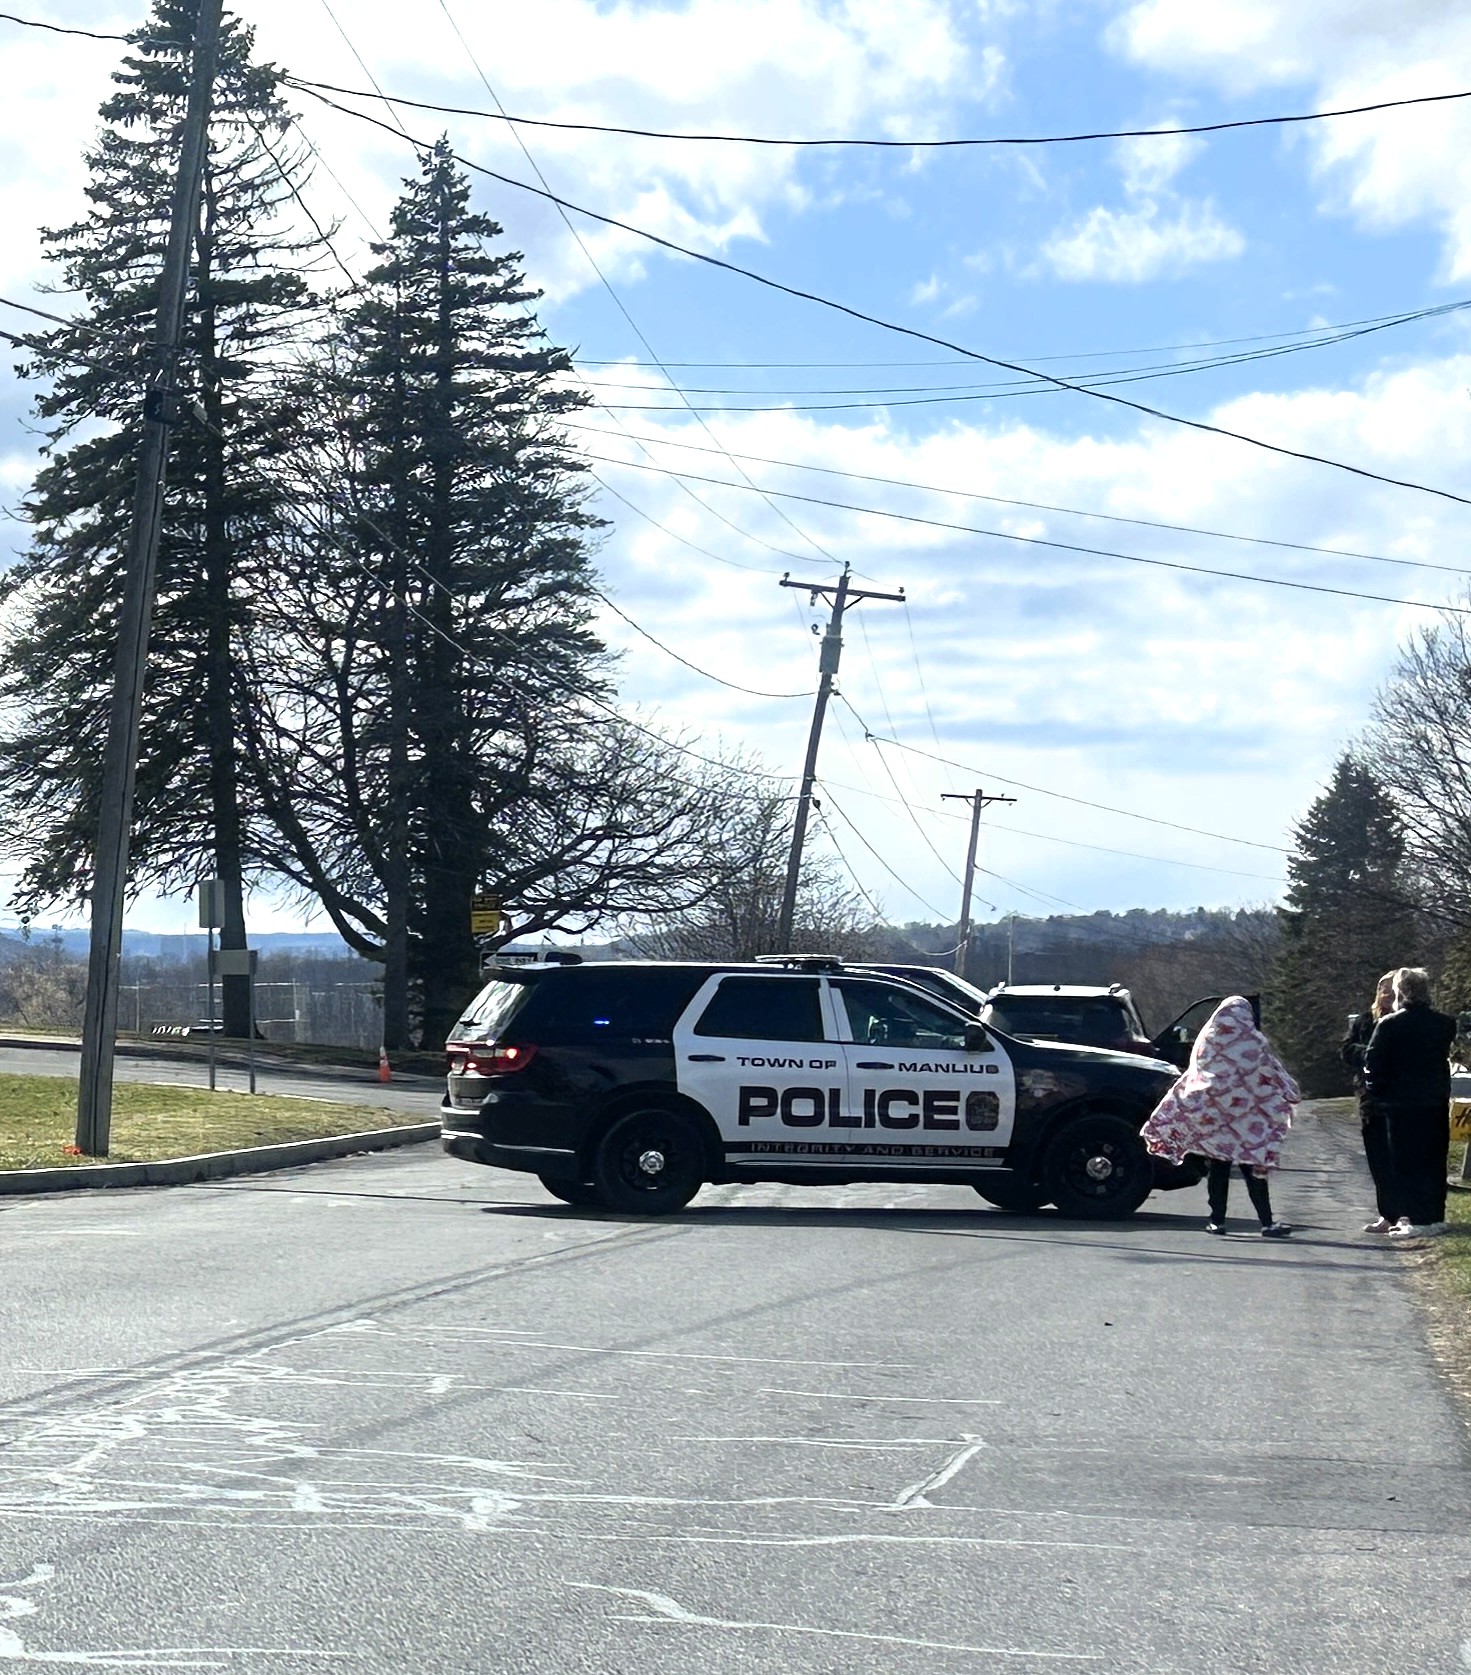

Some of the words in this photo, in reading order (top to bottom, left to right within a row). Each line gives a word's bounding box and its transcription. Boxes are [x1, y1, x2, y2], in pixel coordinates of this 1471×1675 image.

[736, 1056, 804, 1068] TOWN
[809, 1059, 837, 1070] OF
[738, 1085, 961, 1131] POLICE
[861, 1145, 904, 1156] AND
